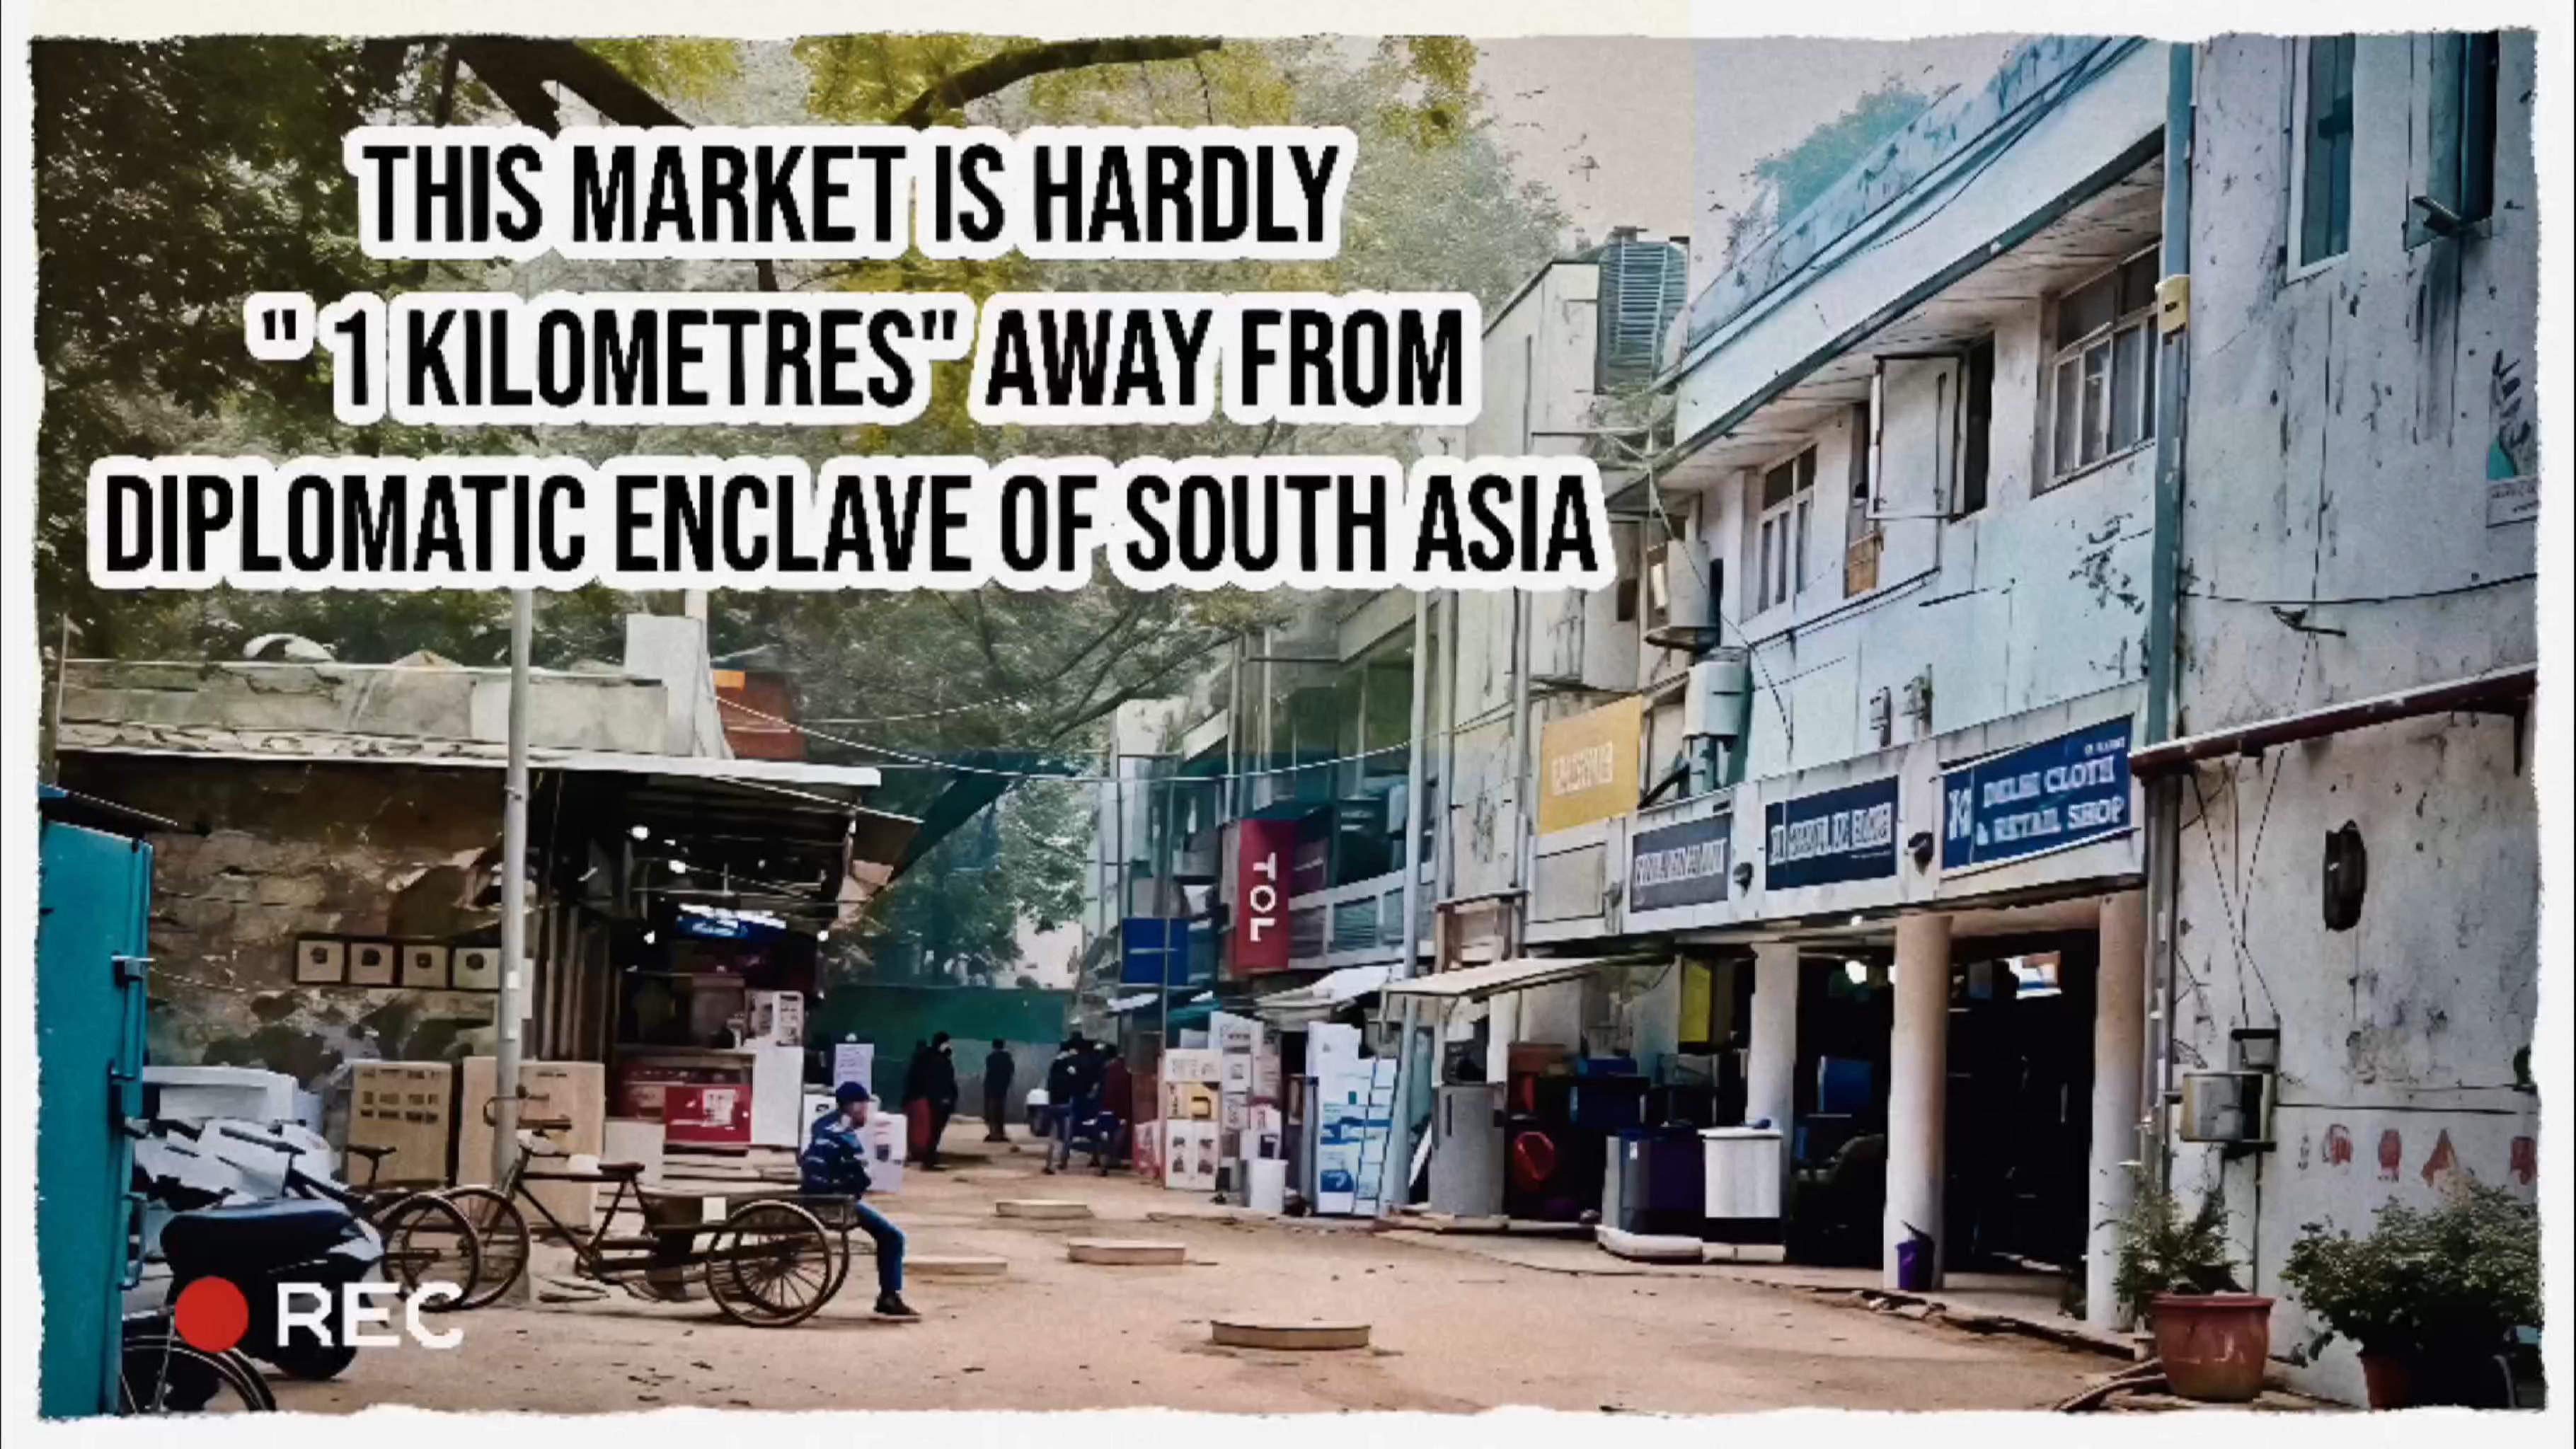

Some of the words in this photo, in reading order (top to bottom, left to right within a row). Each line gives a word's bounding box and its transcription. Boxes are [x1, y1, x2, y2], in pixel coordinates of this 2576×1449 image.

[2044, 754, 2115, 793] CLOTH
[2067, 795, 2124, 830] SHOP
[1250, 852, 1277, 942] TOL
